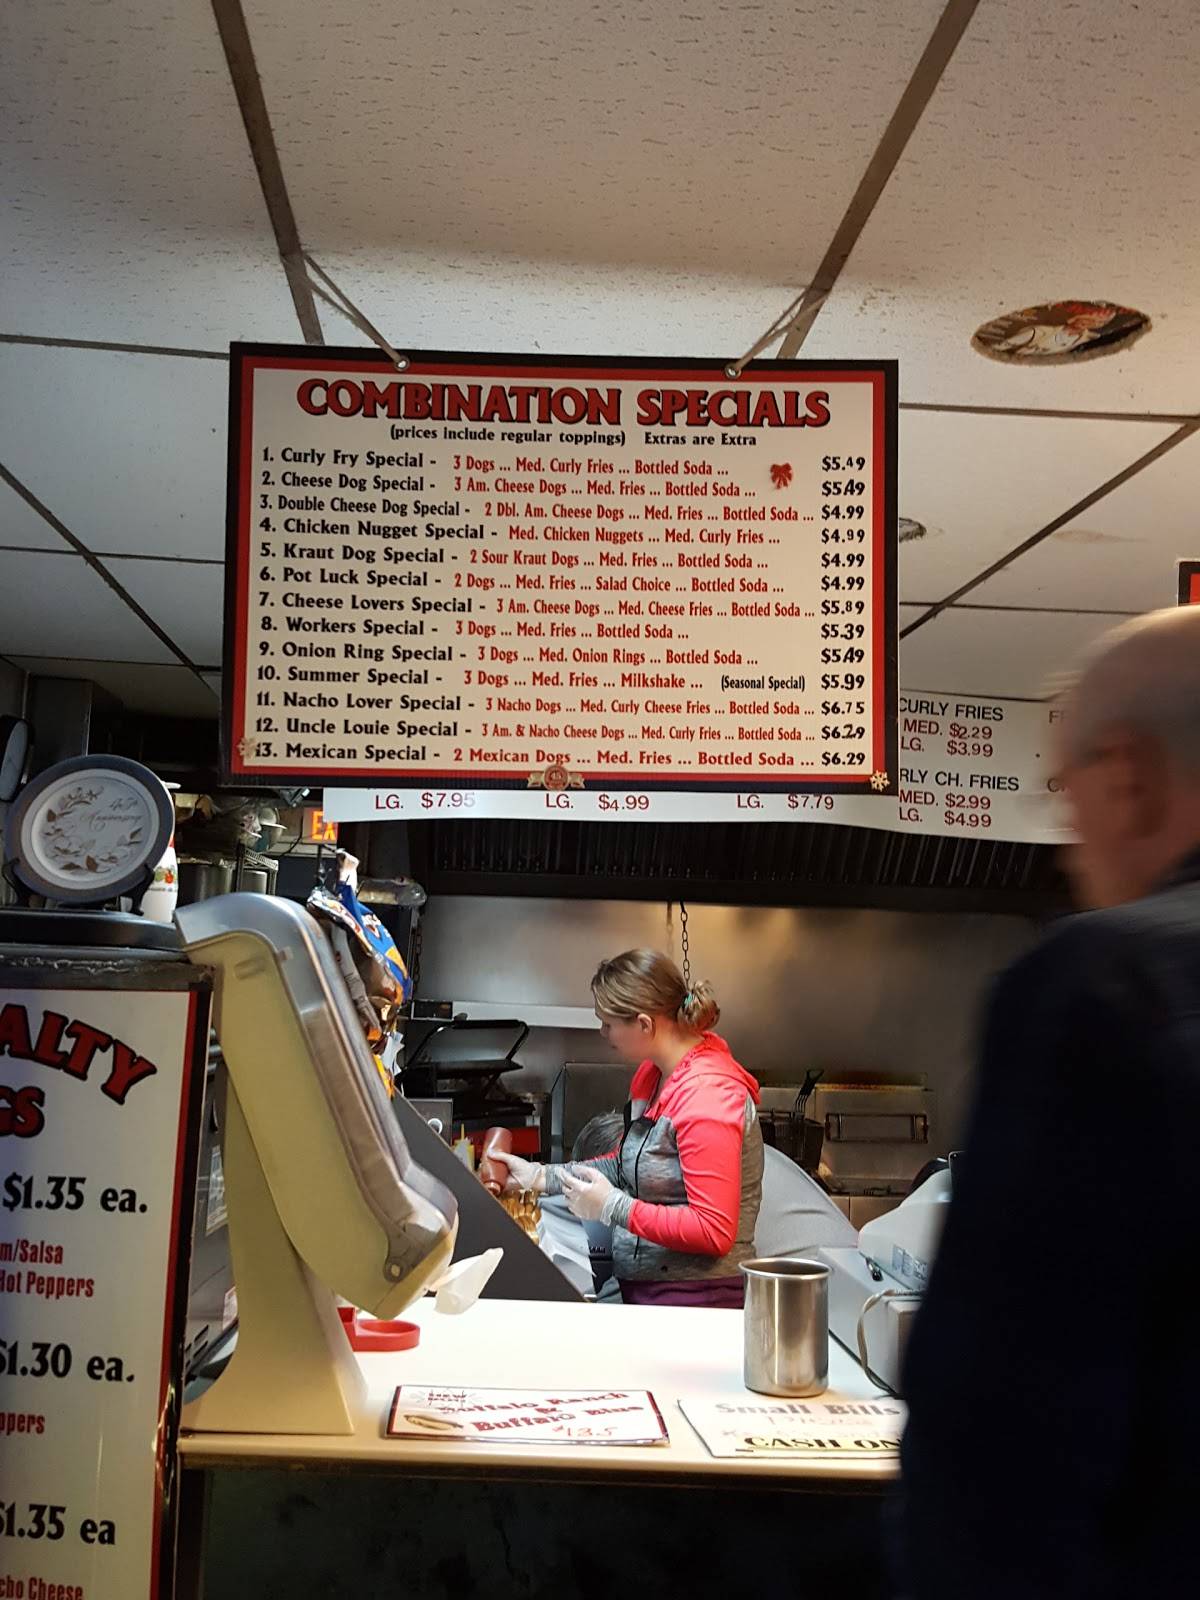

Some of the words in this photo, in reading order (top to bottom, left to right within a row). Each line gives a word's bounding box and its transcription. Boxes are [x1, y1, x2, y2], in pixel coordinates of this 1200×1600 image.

[296, 378, 622, 426] COMBINATION
[636, 388, 830, 428] SPECIALS
[390, 424, 438, 441] (prices
[443, 426, 495, 441] include
[501, 429, 553, 444] regular
[559, 430, 626, 447] toppings)
[644, 431, 687, 446] Extras
[692, 436, 715, 446] are
[721, 432, 757, 446] Extra
[263, 447, 274, 462] 1.
[281, 447, 326, 466] Curly
[333, 449, 359, 468] Fry
[366, 451, 423, 469] Special
[453, 455, 461, 470] 3
[466, 455, 495, 474] Dogs
[516, 457, 545, 472] Med.
[550, 458, 582, 475] Curly
[587, 458, 614, 474] Fries
[635, 459, 679, 475] Bottled
[684, 460, 712, 475] Soda
[822, 456, 865, 472] $5.49
[259, 517, 276, 532] 4.
[283, 518, 350, 535] Chicken
[357, 520, 418, 540] Nugget
[425, 523, 484, 540] Special
[509, 525, 538, 540] Med.
[543, 526, 590, 541] Chicken
[595, 527, 643, 545] Nuggets
[665, 528, 694, 543] Med.
[699, 528, 731, 546] Curly
[737, 529, 764, 544] Fries
[821, 528, 865, 544] $4.99
[260, 542, 276, 557] 5.
[284, 543, 334, 559] Kraut
[342, 545, 376, 564] Dog
[383, 546, 444, 564] Special
[470, 549, 477, 563] 2
[482, 549, 509, 564] Sour
[514, 550, 546, 565] Kraut
[552, 551, 579, 568] Dogs
[600, 552, 627, 567] Med.
[632, 552, 657, 567] Fries
[678, 553, 720, 568] Bottled
[725, 553, 752, 568] Soda
[821, 552, 865, 569] $4.99
[259, 566, 275, 581] 6.
[283, 567, 312, 583] Pot
[320, 568, 359, 584] Luck
[367, 570, 427, 588] Special
[455, 573, 462, 587] 2
[467, 573, 495, 591] Dogs
[516, 574, 544, 589] Med.
[550, 575, 575, 590] Fries
[596, 576, 627, 591] Salad
[632, 576, 671, 591] Choice
[692, 577, 735, 592] Bottled
[739, 578, 768, 592] Soda
[821, 575, 865, 592] $4.99
[261, 616, 278, 631] 8.
[285, 616, 356, 633] Workers
[363, 619, 424, 637] Special
[456, 620, 463, 635] 3
[468, 621, 496, 638] Dogs
[517, 621, 545, 637] Med.
[550, 622, 576, 637] Fries
[597, 623, 640, 638] Bottled
[645, 624, 673, 639] Soda
[821, 622, 864, 640] $5.39
[259, 641, 274, 656] 9.
[282, 641, 336, 658] Onion
[344, 643, 384, 662] Ring
[392, 645, 452, 663] Special
[478, 646, 485, 660] 3
[490, 646, 518, 664] Dogs
[539, 647, 567, 662] Med.
[572, 648, 608, 663] Onion
[613, 648, 645, 666] Rings
[666, 649, 709, 664] Bottled
[714, 650, 742, 664] Soda
[258, 665, 280, 680] 10.
[288, 666, 360, 683] Summer
[367, 668, 428, 686] Special
[464, 670, 472, 685] 3
[478, 670, 508, 688] Dogs
[532, 671, 563, 686] Med.
[569, 672, 598, 687] Fries
[621, 673, 685, 688] Milkshake
[721, 675, 764, 692] (Seasonal
[768, 675, 805, 692] Special)
[821, 673, 865, 691] $5.99
[257, 691, 275, 706] 11.
[283, 691, 339, 708] Nacho
[346, 693, 393, 709] Lover
[400, 694, 461, 712] Special
[486, 697, 493, 711] 3
[497, 698, 531, 711] Nacho
[536, 698, 561, 714] Dogs
[581, 699, 606, 712] Med.
[611, 699, 640, 715] Curly
[645, 700, 682, 713] Cheese
[686, 700, 710, 714] Fries
[729, 701, 769, 714] Bottled
[773, 701, 799, 715] Soda
[821, 700, 865, 716] $6.75
[955, 703, 1004, 722] FRIES
[903, 718, 943, 736] MED.
[949, 721, 993, 740] $2.29
[900, 736, 925, 752] LG.
[946, 739, 993, 758] $3.99
[935, 770, 963, 788] CH.
[969, 774, 1020, 792] FRIES
[375, 794, 404, 810] LG.
[545, 792, 574, 809] LG.
[598, 793, 650, 812] $4.99
[737, 793, 764, 809] LG.
[787, 793, 834, 810] $7.79
[899, 788, 939, 806] MED.
[945, 792, 991, 810] $2.99
[899, 806, 923, 822] LG.
[944, 809, 992, 828] $4.99
[0, 1002, 158, 1106] ALTY
[2, 1171, 87, 1214] $1.35
[99, 1186, 148, 1214] ea.
[25, 1270, 94, 1300] Peppers
[86, 1355, 135, 1382] ea.
[544, 1393, 629, 1405] Ranch
[715, 1402, 812, 1415] Small
[824, 1403, 901, 1416] Bills
[470, 1414, 576, 1431] Buffalo
[744, 1437, 842, 1449] CASH
[0, 1501, 67, 1540] 1.35
[79, 1518, 116, 1545] ea
[28, 1576, 84, 1600] Cheese
